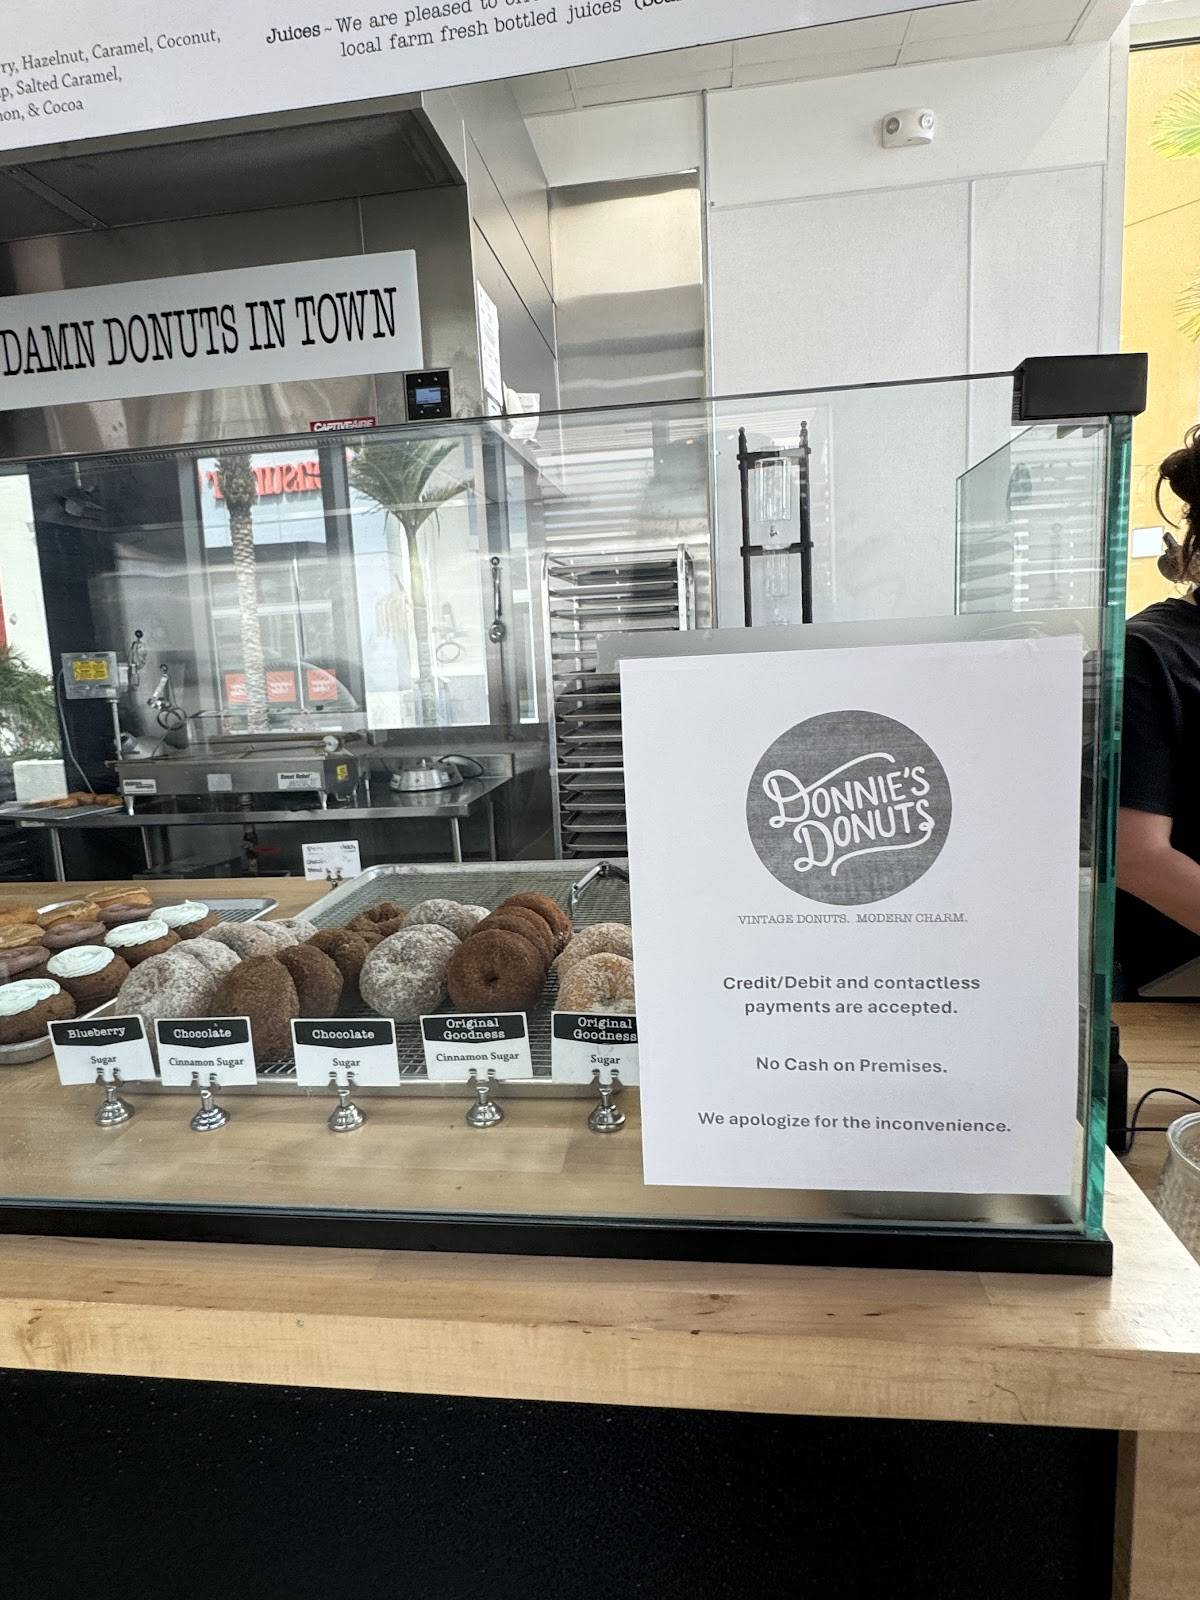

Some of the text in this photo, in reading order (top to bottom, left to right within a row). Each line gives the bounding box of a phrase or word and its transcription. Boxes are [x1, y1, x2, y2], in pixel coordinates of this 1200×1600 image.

[266, 23, 320, 44] Juices
[336, 16, 362, 33] We
[369, 13, 398, 28] are
[404, 0, 473, 26] pleased
[340, 37, 382, 57] local
[389, 30, 434, 50] farm
[440, 21, 489, 43] fresh
[494, 8, 557, 33] bottled
[566, 0, 622, 24] juices
[22, 48, 89, 70] Hazelnut,
[92, 37, 154, 59] Caramel,
[157, 29, 221, 50] Coconut,
[16, 75, 59, 95] Salted
[62, 66, 122, 88] Caramel,
[28, 103, 40, 117] &
[43, 98, 84, 115] Cocoa
[0, 287, 396, 376] DAMN DONUTS IN TOWN
[763, 752, 929, 828] DONNIE'S
[794, 799, 935, 876] DONUTS
[737, 913, 967, 924] VINTAGE DONUTS. MODERN CHARM.
[724, 976, 980, 989] Credit/Debit and contactless
[746, 1001, 957, 1016] payments are accepted.
[446, 1017, 500, 1029] Original
[577, 1017, 633, 1029] Original
[67, 1025, 126, 1040] Blueberry
[173, 1028, 232, 1040] Chocolate
[311, 1028, 375, 1040] Chocolate
[442, 1029, 506, 1040] Goodness
[573, 1029, 637, 1042] Goodness
[90, 1056, 116, 1065] Sugar
[169, 1058, 243, 1068] Cinnamon Sugar
[333, 1058, 360, 1068] Sugar
[491, 1052, 519, 1062] Sugar
[591, 1055, 620, 1066] Sugar
[757, 1057, 947, 1072] No Cash on Premises.
[698, 1112, 1011, 1132] We apologize for the inconvenience.
